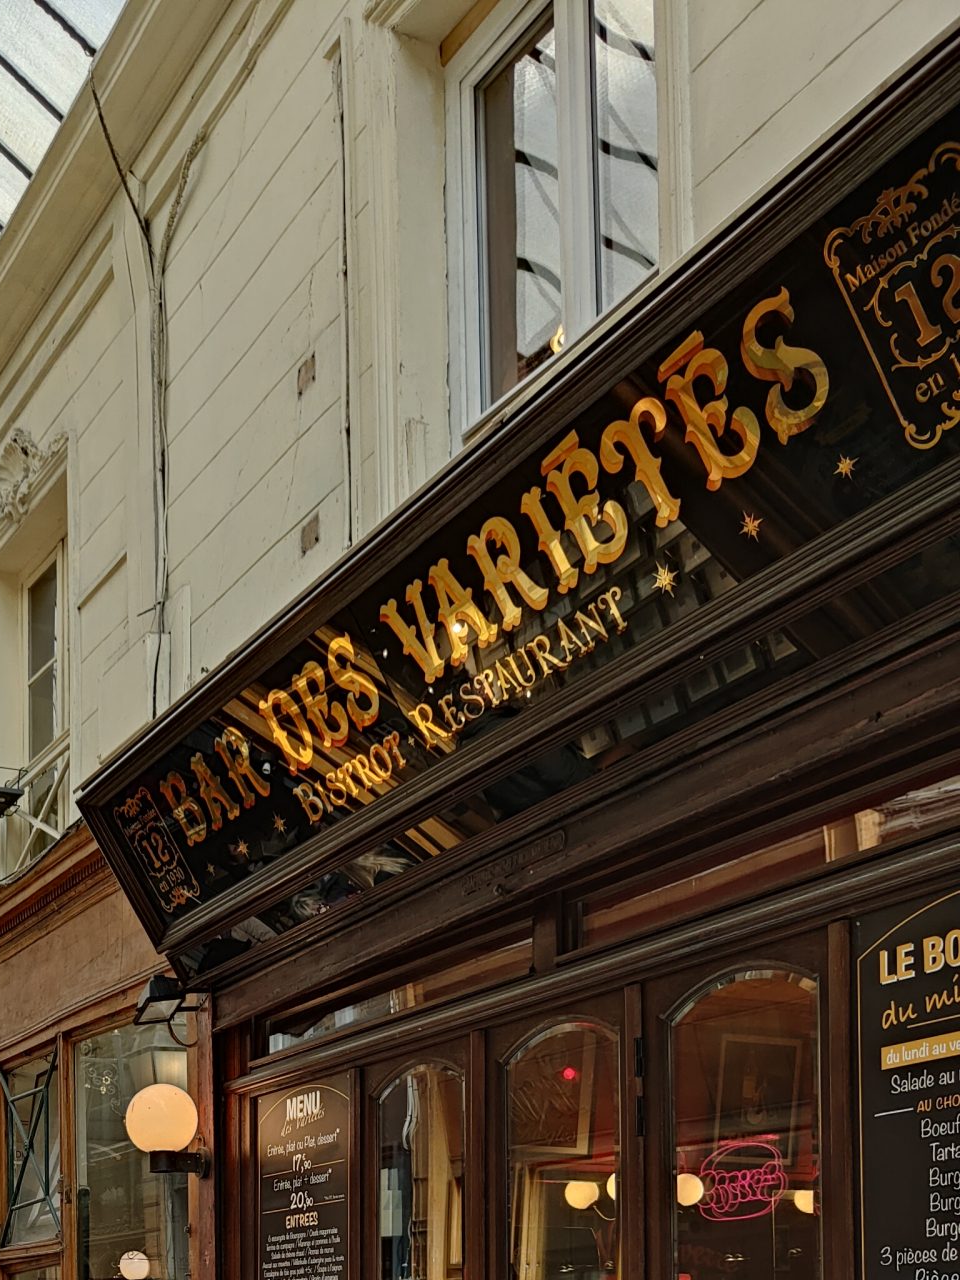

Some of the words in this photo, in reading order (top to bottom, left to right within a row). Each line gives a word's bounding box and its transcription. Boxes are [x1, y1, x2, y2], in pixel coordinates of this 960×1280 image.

[844, 239, 908, 292] Maison
[915, 371, 946, 404] en
[160, 726, 271, 847] BAR
[259, 632, 380, 777] DES
[379, 286, 829, 684] VARIÉTÉS
[293, 730, 407, 827] BISTROT
[408, 586, 628, 751] RESTAURANT
[142, 832, 170, 869] 12
[879, 942, 916, 985] LE
[881, 999, 918, 1030] du
[886, 1048, 900, 1065] du
[901, 1042, 929, 1062] lundi
[932, 1042, 946, 1055] au
[891, 1070, 934, 1094] Salade
[939, 1071, 954, 1085] au
[286, 1090, 321, 1121] MENU
[917, 1098, 932, 1112] AU
[285, 1211, 319, 1229] ENTREES
[880, 1246, 892, 1266] 3
[896, 1248, 937, 1271] pièces
[942, 1242, 958, 1261] de
